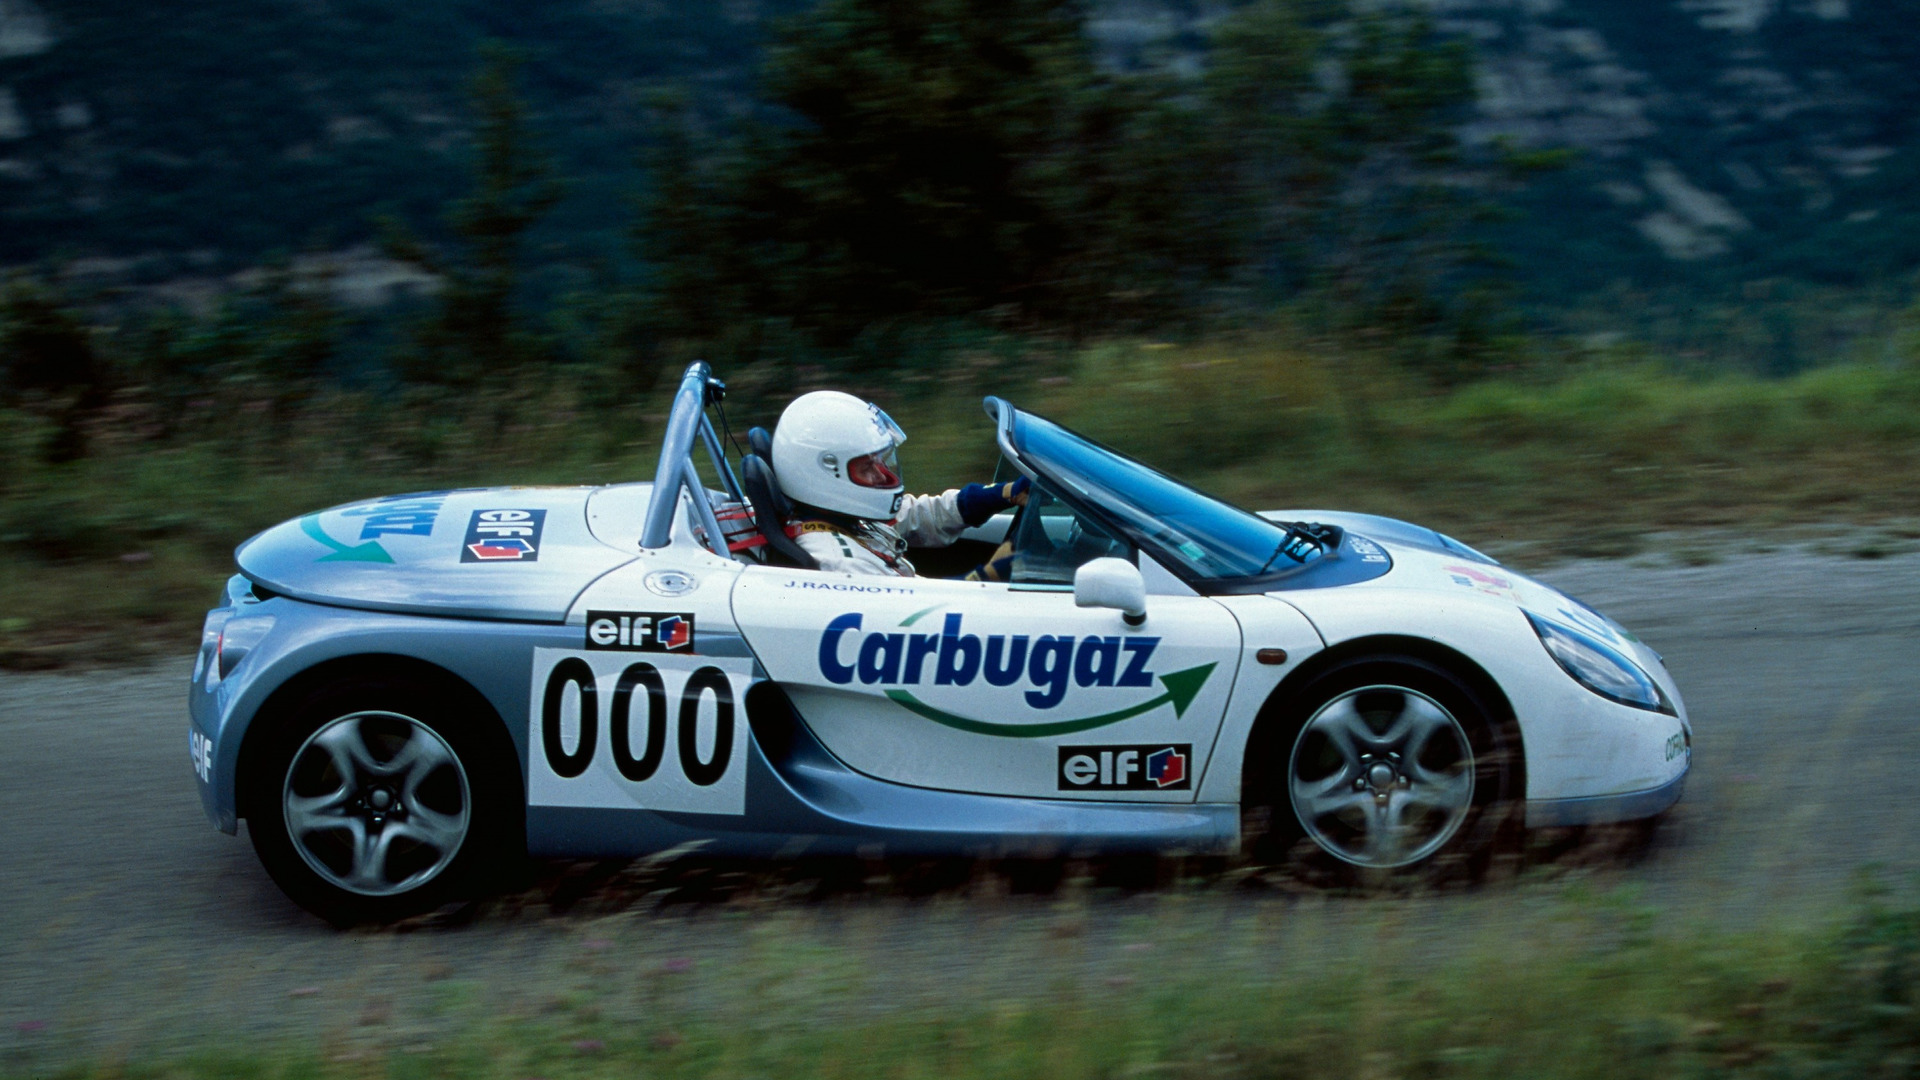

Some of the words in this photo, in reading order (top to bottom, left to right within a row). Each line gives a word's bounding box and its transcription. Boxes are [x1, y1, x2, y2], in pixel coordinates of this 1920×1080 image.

[477, 509, 535, 536] elf
[784, 580, 914, 595] J.RAGNOTTI
[589, 616, 652, 646] elf
[818, 612, 1162, 710] Carbugaz
[542, 657, 735, 787] 000
[193, 731, 212, 784] elf
[1063, 751, 1139, 786] elf
